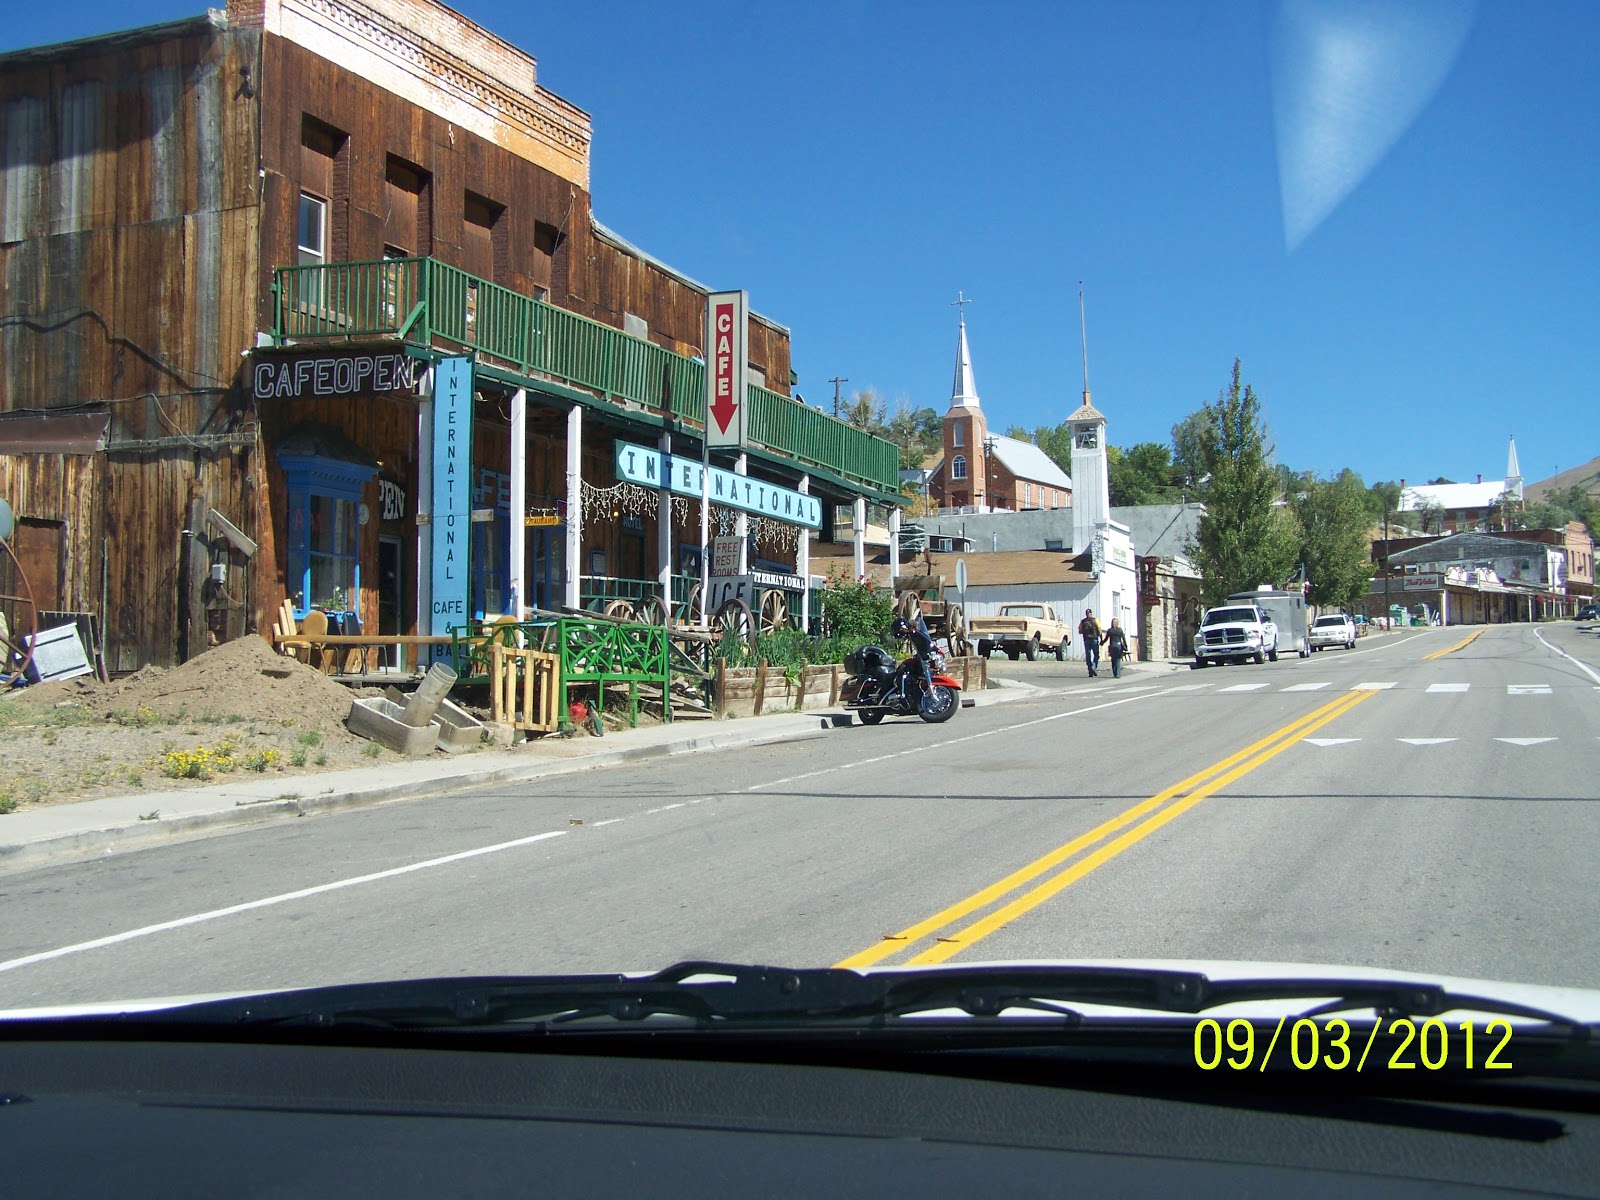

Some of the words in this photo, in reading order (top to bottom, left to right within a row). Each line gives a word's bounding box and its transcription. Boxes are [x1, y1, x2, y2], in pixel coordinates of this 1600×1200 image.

[717, 313, 731, 397] CAFE
[446, 360, 458, 580] INTERNATIONAL
[716, 542, 738, 553] FREE
[715, 555, 737, 566] REST
[711, 582, 746, 609] ICE
[433, 600, 463, 615] CAFE
[445, 621, 454, 635] &
